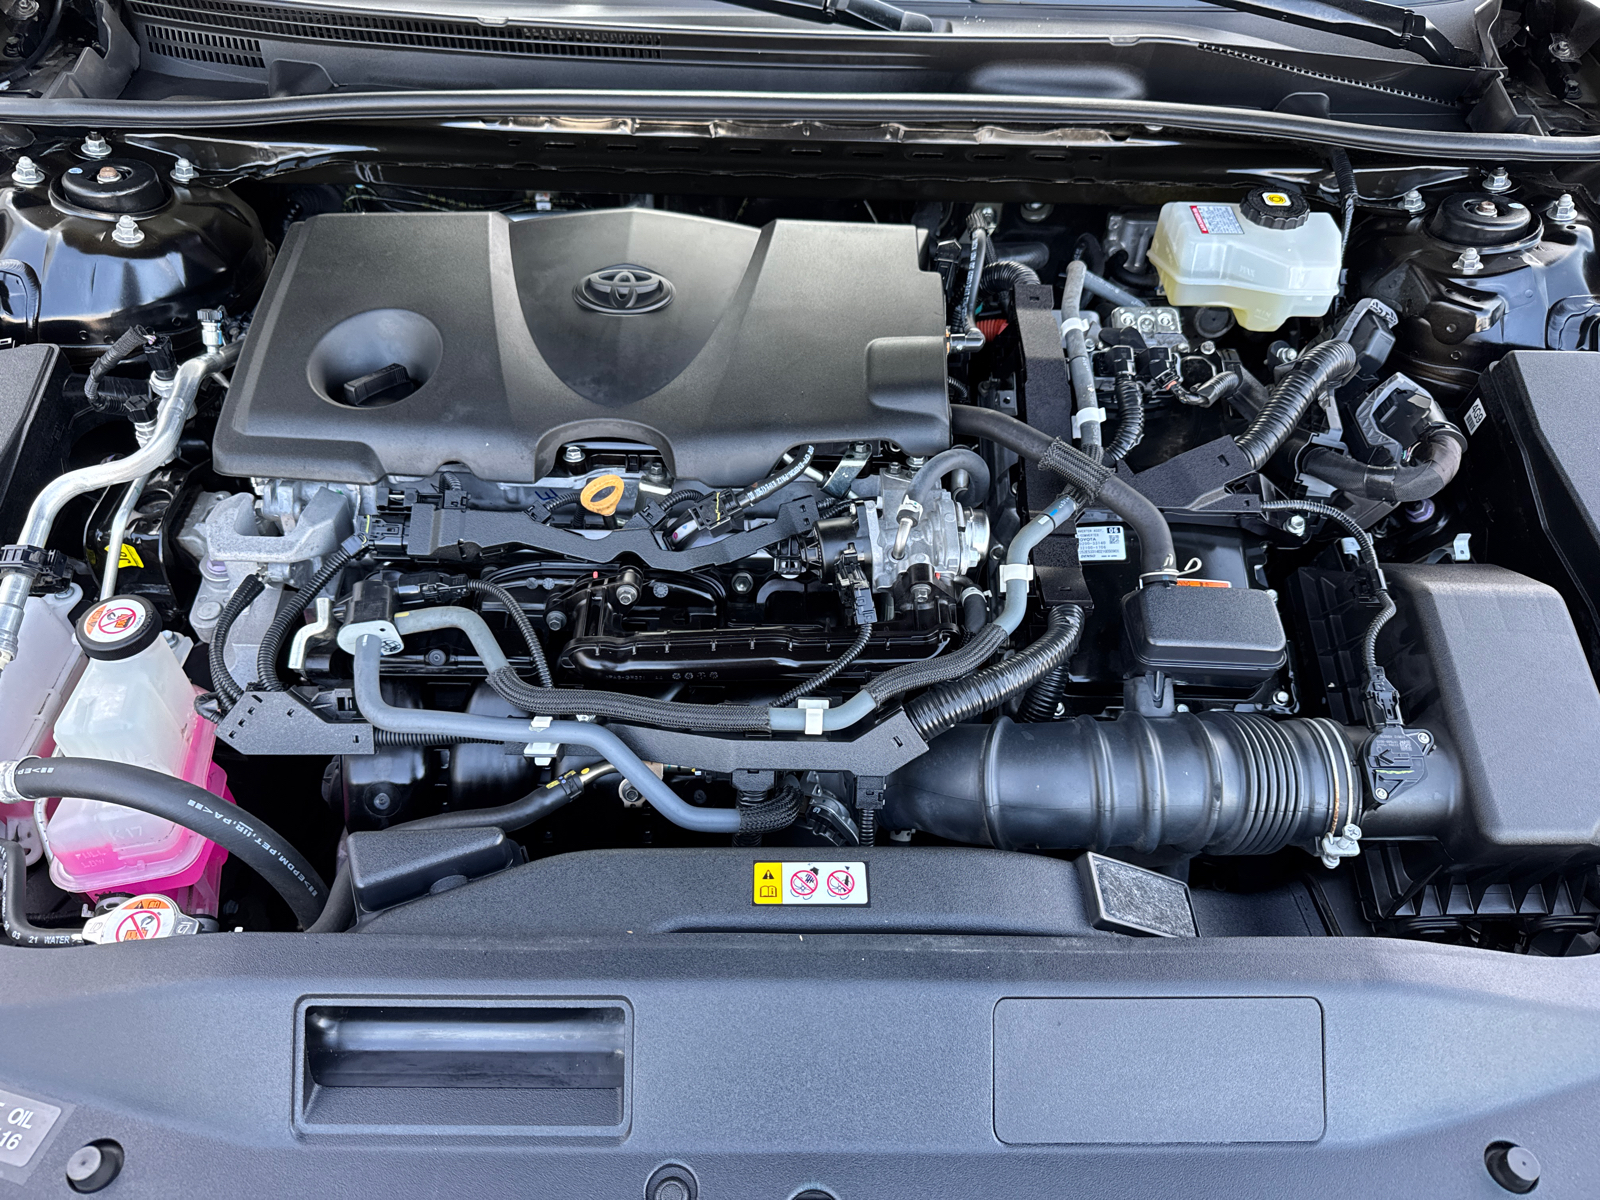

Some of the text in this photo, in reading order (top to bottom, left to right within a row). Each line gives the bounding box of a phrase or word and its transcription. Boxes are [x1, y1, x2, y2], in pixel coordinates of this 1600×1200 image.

[1471, 403, 1484, 424] 4G9
[28, 936, 38, 944] 21
[43, 935, 71, 944] WATER
[7, 1107, 34, 1130] OIL
[0, 1130, 23, 1151] 16
